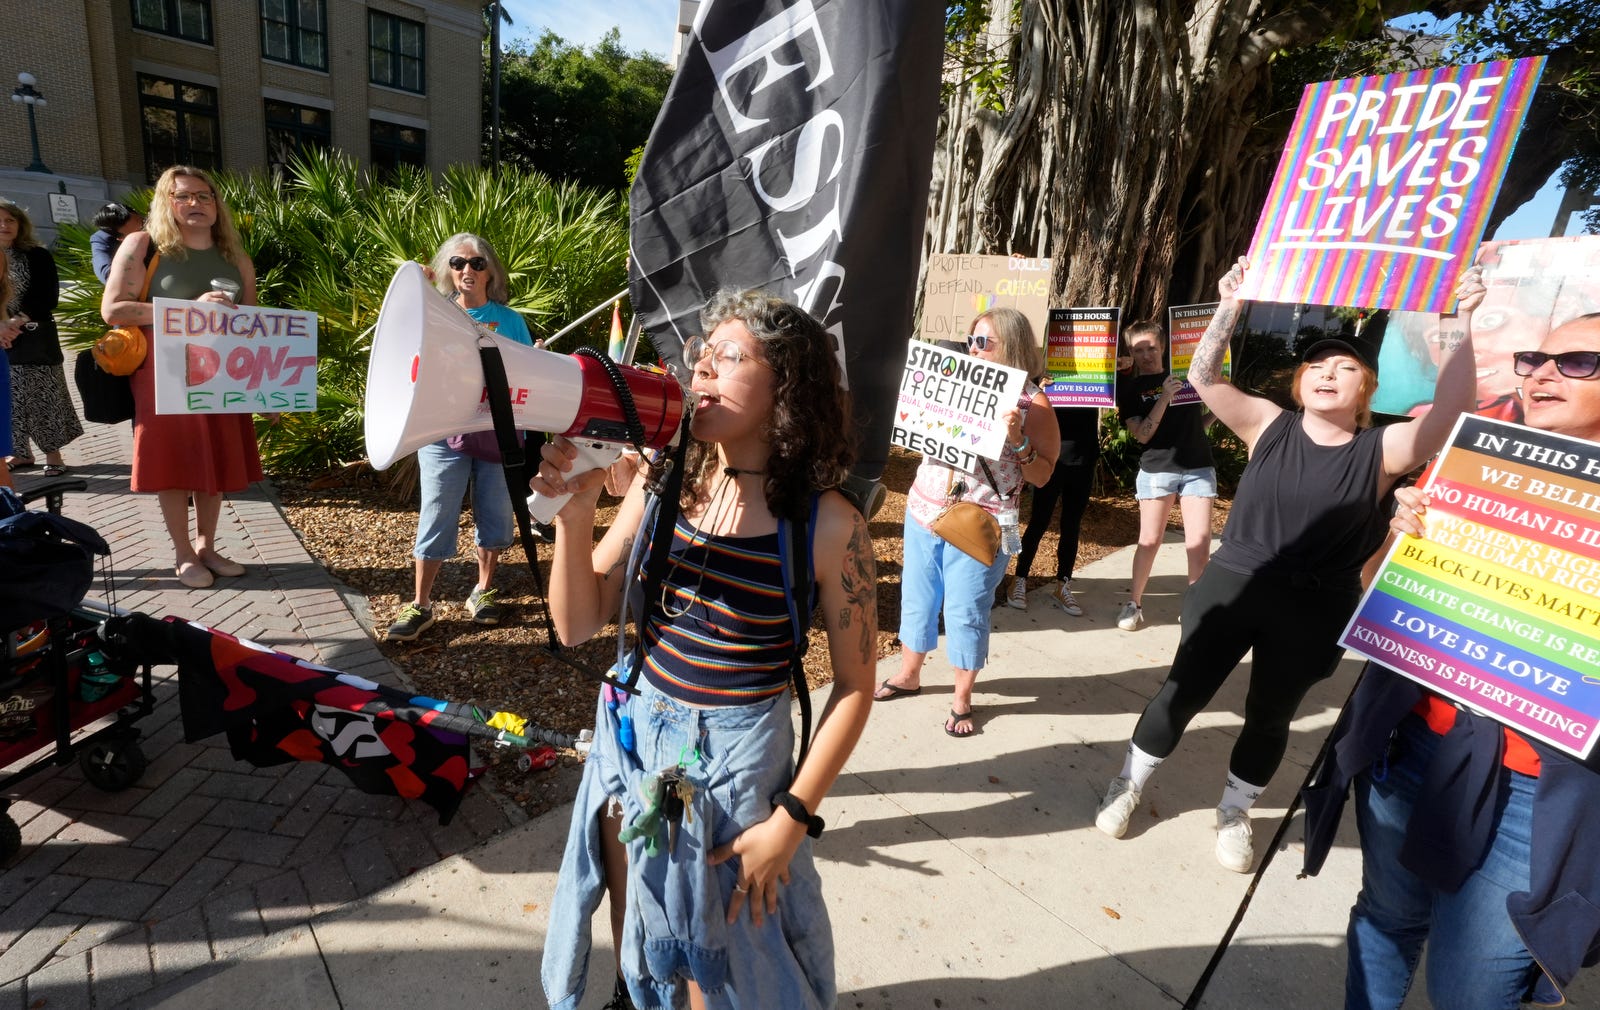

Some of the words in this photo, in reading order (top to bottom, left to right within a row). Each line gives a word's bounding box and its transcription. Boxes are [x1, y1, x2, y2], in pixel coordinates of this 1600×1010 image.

[1315, 76, 1503, 139] PRIDE
[1297, 135, 1488, 191] SAVES
[1281, 193, 1463, 240] LIVES
[930, 280, 982, 295] DEFEND
[995, 278, 1048, 296] QUEENS
[933, 256, 989, 272] PROTECT
[1008, 258, 1050, 270] DOLLS
[163, 305, 310, 338] EDUCATE
[185, 343, 317, 390] DONT
[908, 346, 1008, 393] STRONGER
[187, 391, 313, 410] ERASE
[897, 393, 921, 408] EQUAL
[924, 402, 954, 418] RIGHTS
[957, 413, 974, 425] FOR
[976, 419, 993, 432] ALL
[905, 367, 998, 420] TOGETHER
[892, 426, 975, 469] RESIST
[1473, 432, 1509, 452] IN
[1512, 440, 1579, 470] THIS
[1429, 483, 1462, 504] NO
[1462, 493, 1552, 531] HUMAN
[1551, 518, 1577, 539] IS
[1481, 465, 1523, 490] WE
[1524, 478, 1600, 514] BELIE
[1424, 527, 1462, 549] ARE
[1462, 538, 1549, 578] HUMAN
[1551, 567, 1600, 598] RIG
[1438, 516, 1543, 559] WOMEN'S
[1543, 547, 1600, 582] RIGH
[1384, 570, 1460, 609] CLIMATE
[1460, 602, 1544, 643] CHANGE
[1544, 633, 1567, 651] IS
[1403, 545, 1469, 578] BLACK
[1472, 570, 1533, 601] LIVES
[1535, 592, 1600, 627] MATT
[1391, 609, 1460, 648] LOVE
[1460, 639, 1489, 660] IS
[1489, 652, 1571, 696] LOVE
[1352, 625, 1437, 671] KINDNESS
[1435, 662, 1456, 680] IS
[1454, 671, 1588, 739] EVERYTHING
